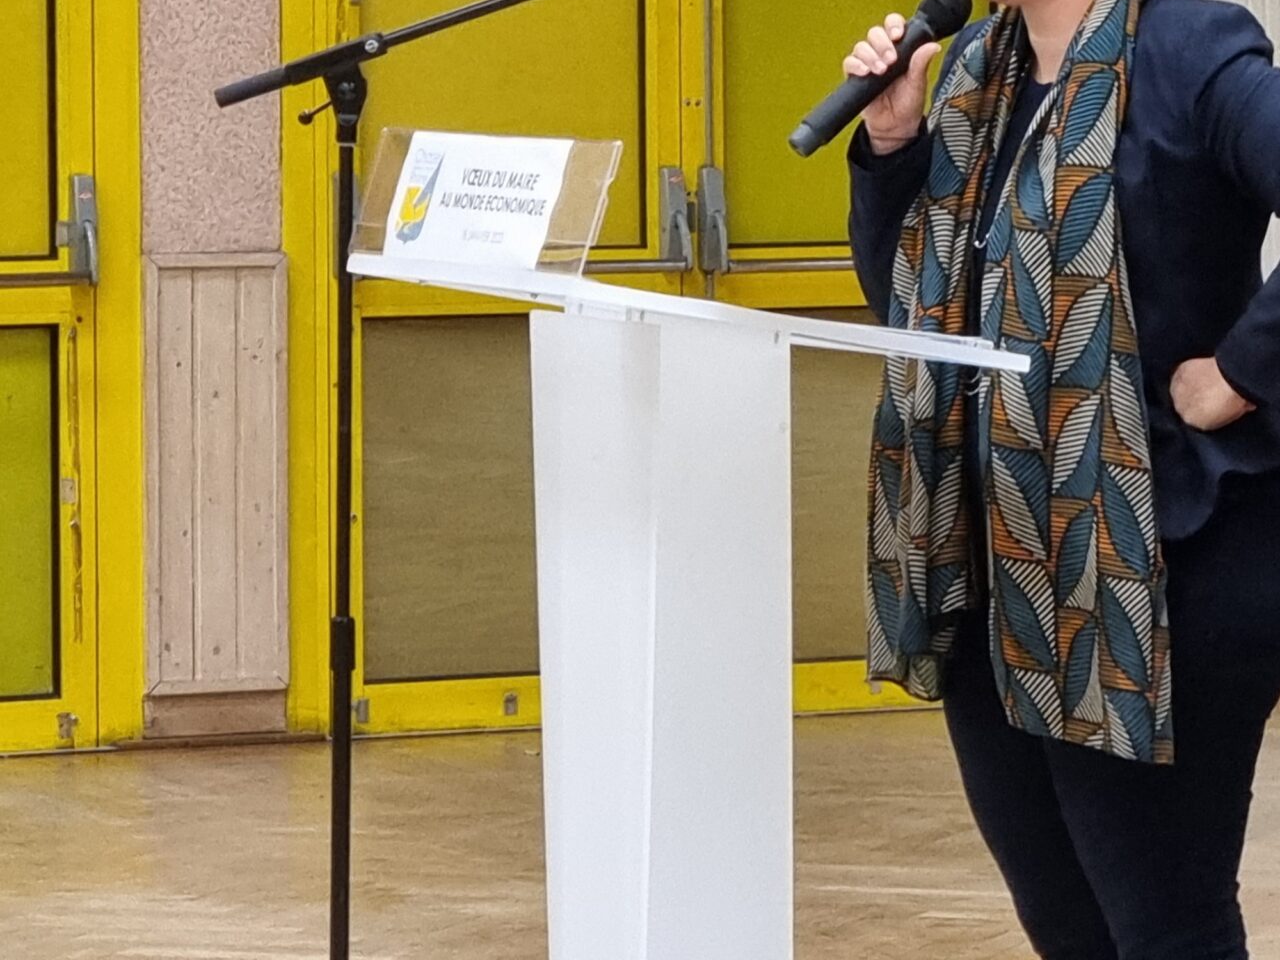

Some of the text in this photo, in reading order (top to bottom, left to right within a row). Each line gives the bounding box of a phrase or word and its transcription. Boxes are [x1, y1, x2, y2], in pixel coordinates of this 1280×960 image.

[492, 170, 507, 189] DU
[506, 171, 540, 191] MAIRE
[439, 192, 453, 208] AU
[453, 193, 485, 211] MONDE
